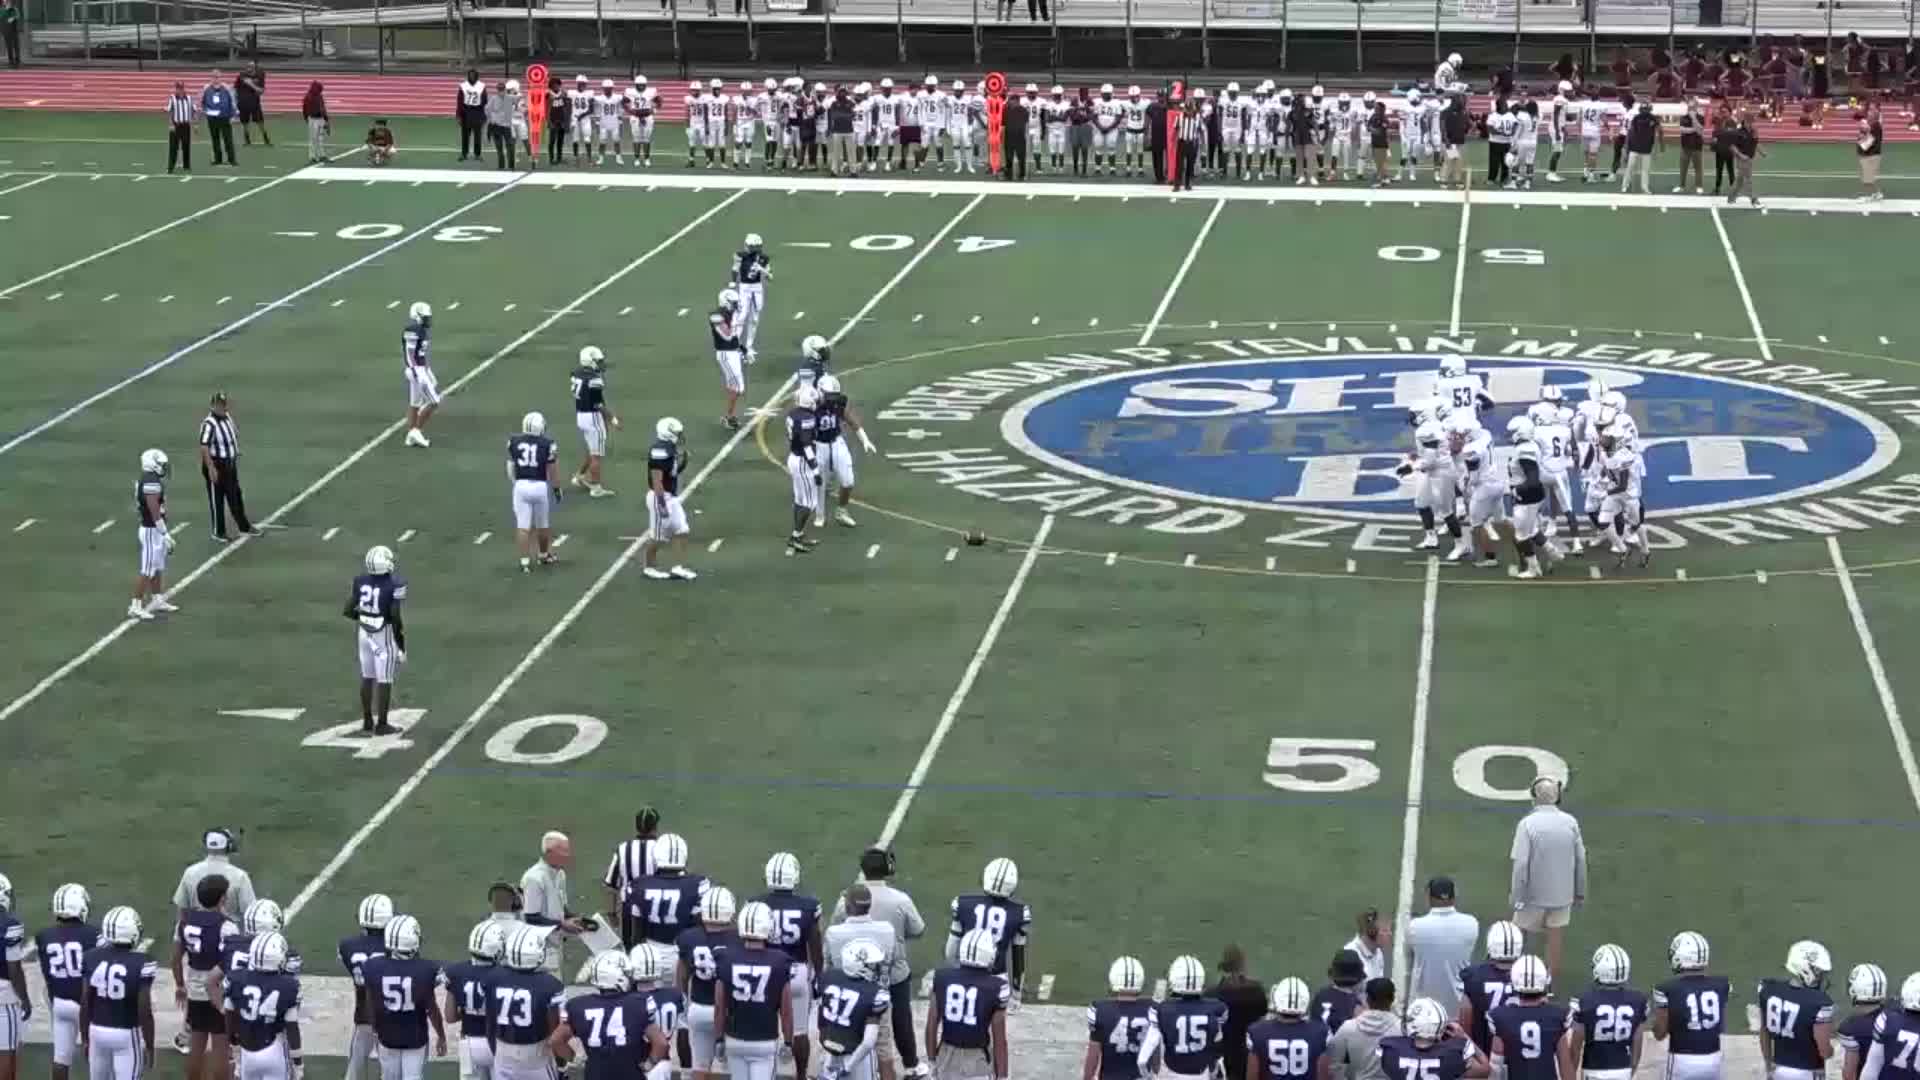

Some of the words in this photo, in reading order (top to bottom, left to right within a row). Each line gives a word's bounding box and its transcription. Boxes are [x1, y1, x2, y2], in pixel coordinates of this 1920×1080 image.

[1584, 108, 1597, 122] 42
[876, 353, 1134, 422] BRENDAN
[1194, 336, 1477, 358] TEVLIN
[1500, 339, 1919, 399] MEMORIAL
[1452, 386, 1472, 408] 53
[1081, 398, 1827, 458] PIRES
[517, 442, 539, 467] 31
[885, 447, 1246, 534] HAZARD
[359, 584, 381, 614] 21
[644, 888, 682, 924] 77
[973, 903, 1008, 942] 18
[46, 941, 83, 979] 20
[90, 961, 127, 1001] 46
[381, 975, 416, 1012] 51
[731, 964, 772, 1003] 57
[240, 985, 281, 1024] 34
[495, 987, 533, 1027] 73
[822, 985, 862, 1027] 37
[945, 983, 980, 1026] 81
[1593, 1003, 1636, 1042] 26
[1684, 990, 1721, 1031] 19
[584, 1006, 627, 1047] 74
[1108, 1016, 1149, 1053] 43
[1175, 1015, 1209, 1053] 15
[1519, 1019, 1542, 1059] 9
[1268, 1038, 1310, 1076] 58
[1891, 1029, 1920, 1073] 7
